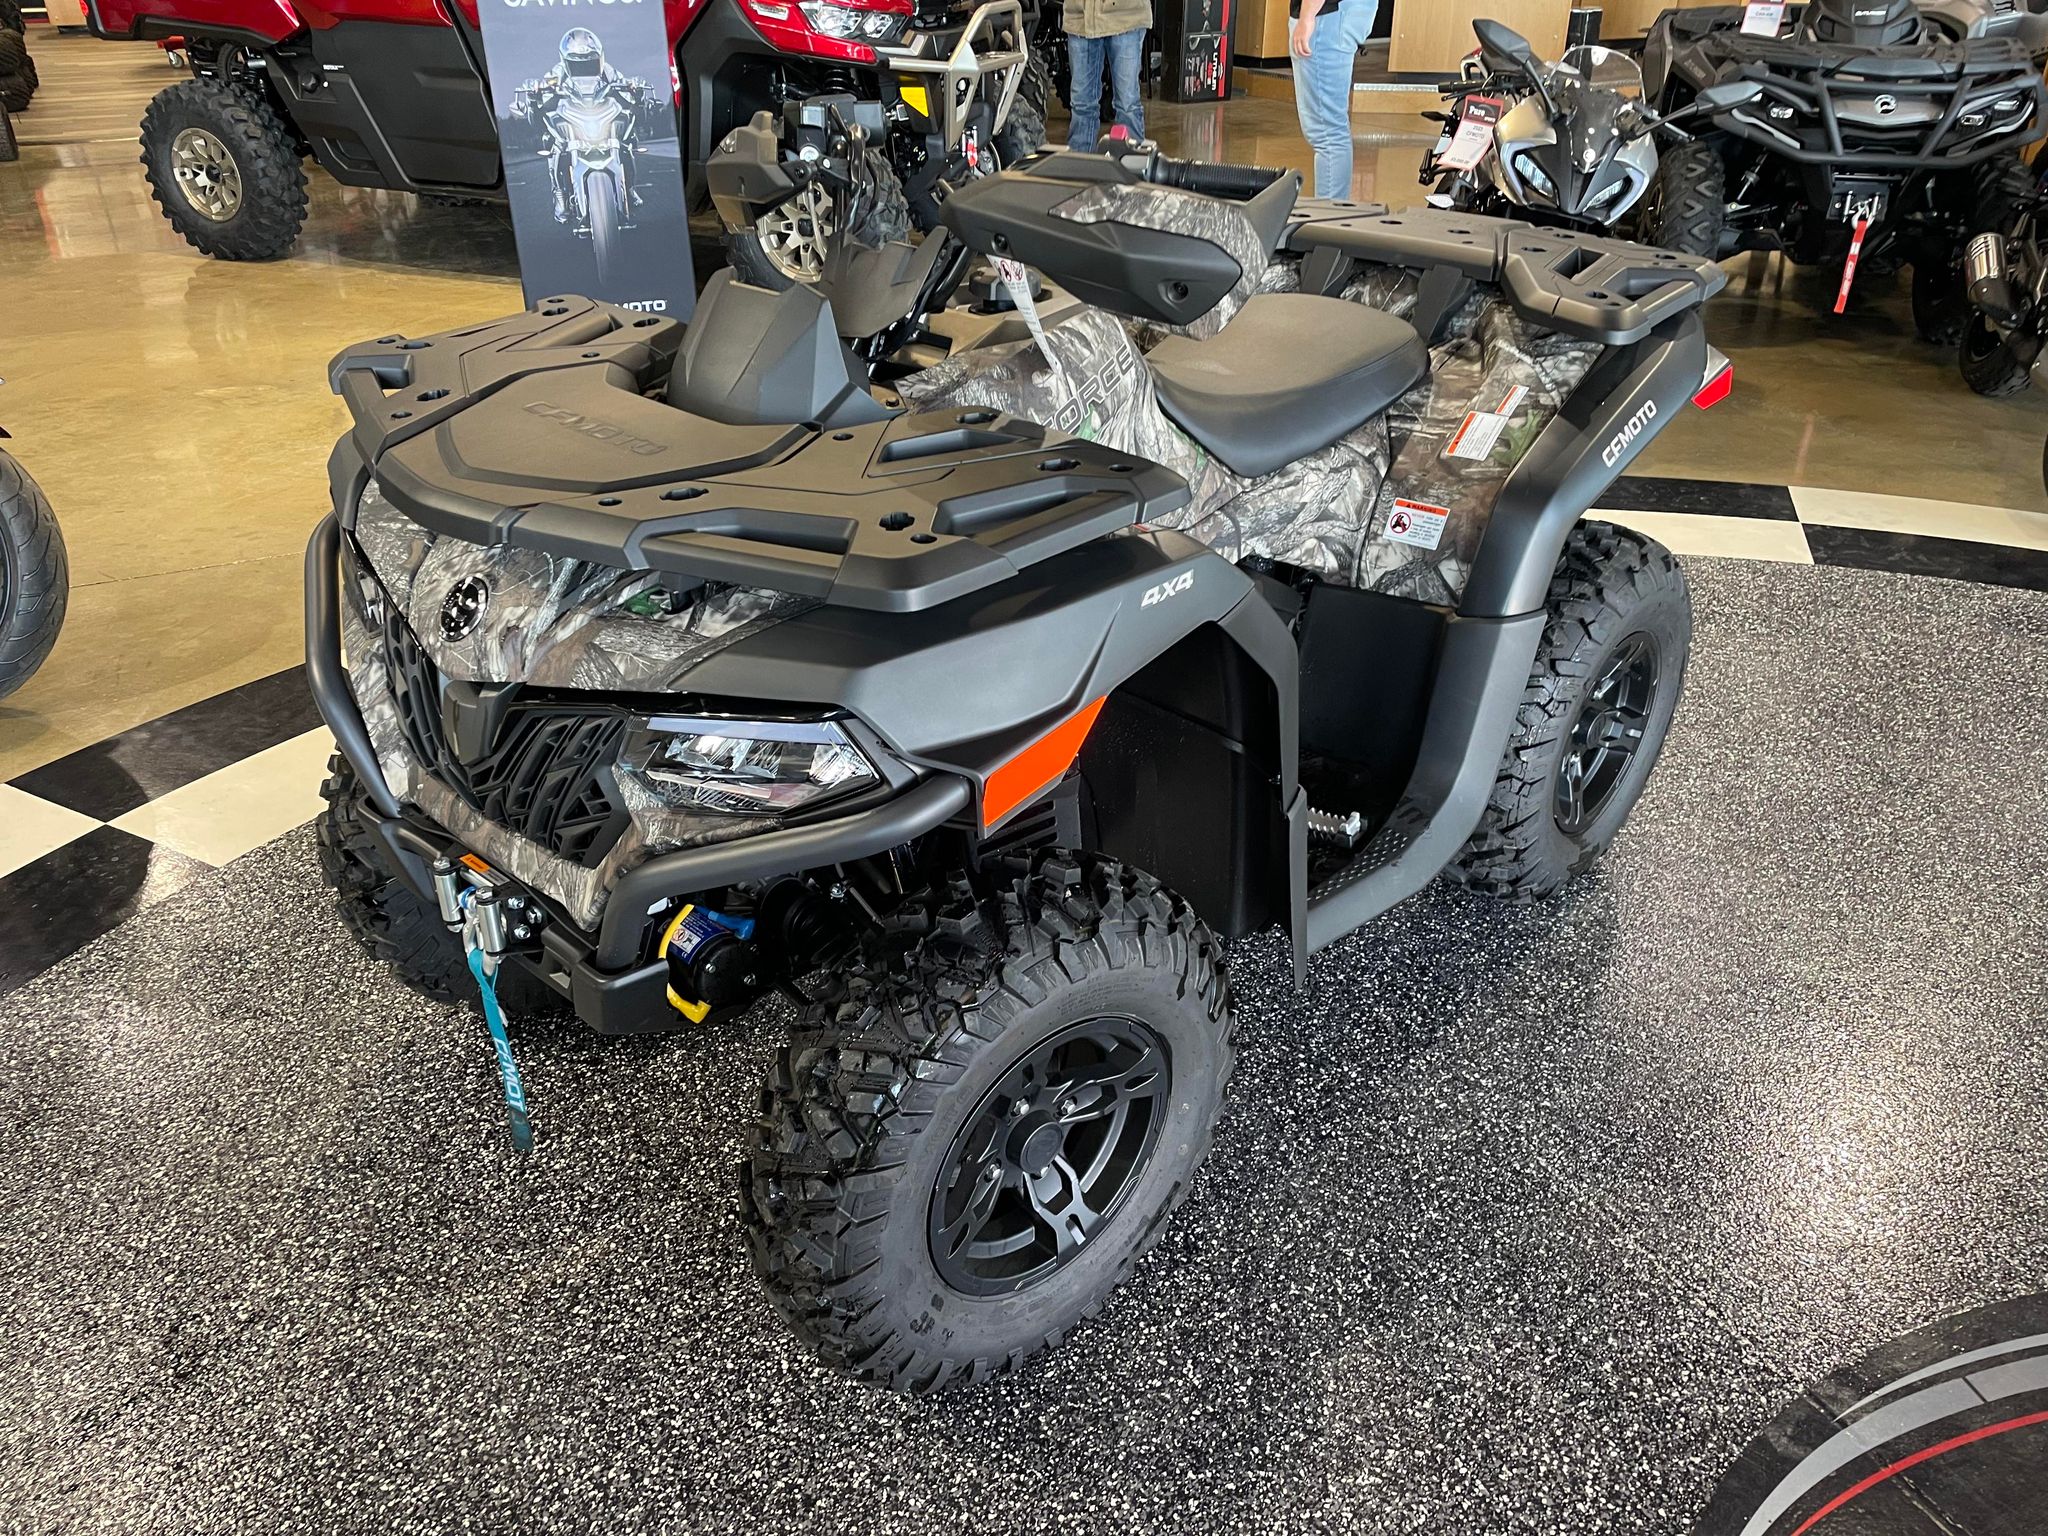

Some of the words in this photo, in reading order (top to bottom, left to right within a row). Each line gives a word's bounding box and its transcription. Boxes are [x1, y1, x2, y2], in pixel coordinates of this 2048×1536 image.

[1042, 343, 1135, 434] ORCE
[522, 401, 669, 455] CFMOTO
[1602, 400, 1657, 468] CFMOTO
